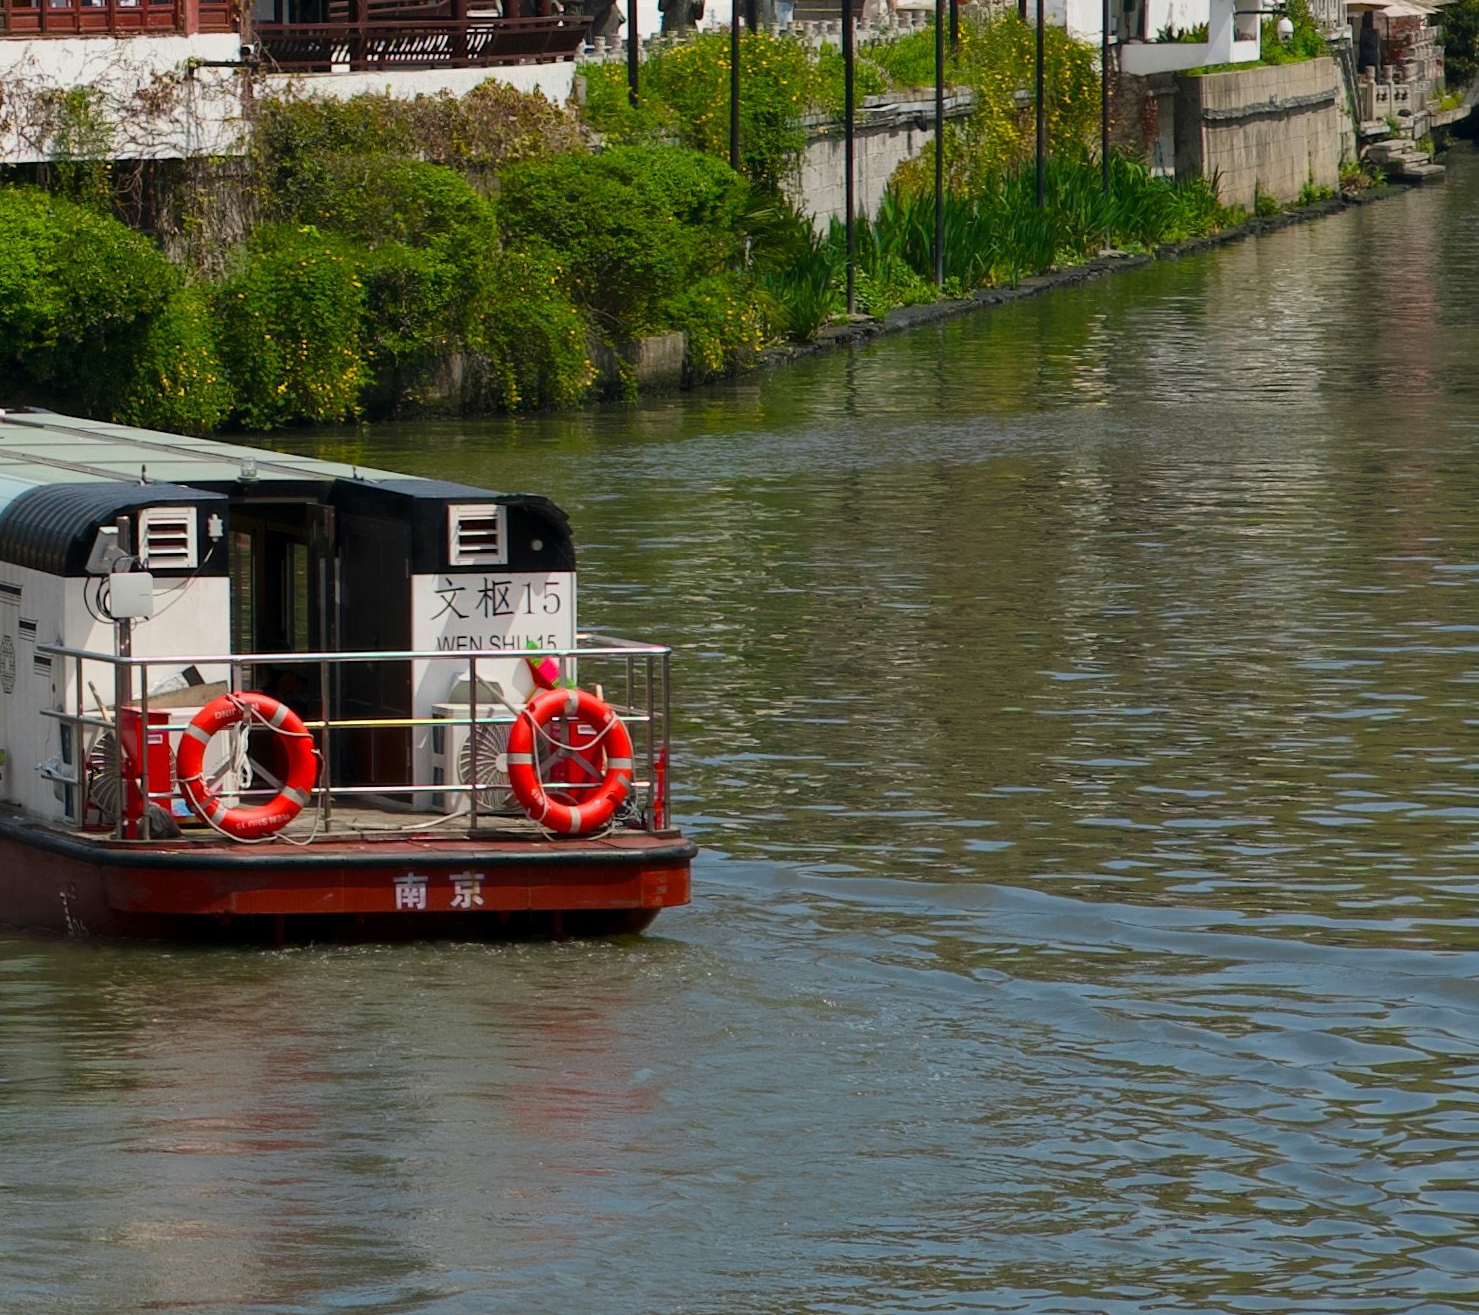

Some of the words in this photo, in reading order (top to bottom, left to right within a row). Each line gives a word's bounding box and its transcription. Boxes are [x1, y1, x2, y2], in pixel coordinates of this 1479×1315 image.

[437, 636, 482, 651] WEN
[538, 635, 557, 650] 15
[392, 870, 486, 910] 南京
